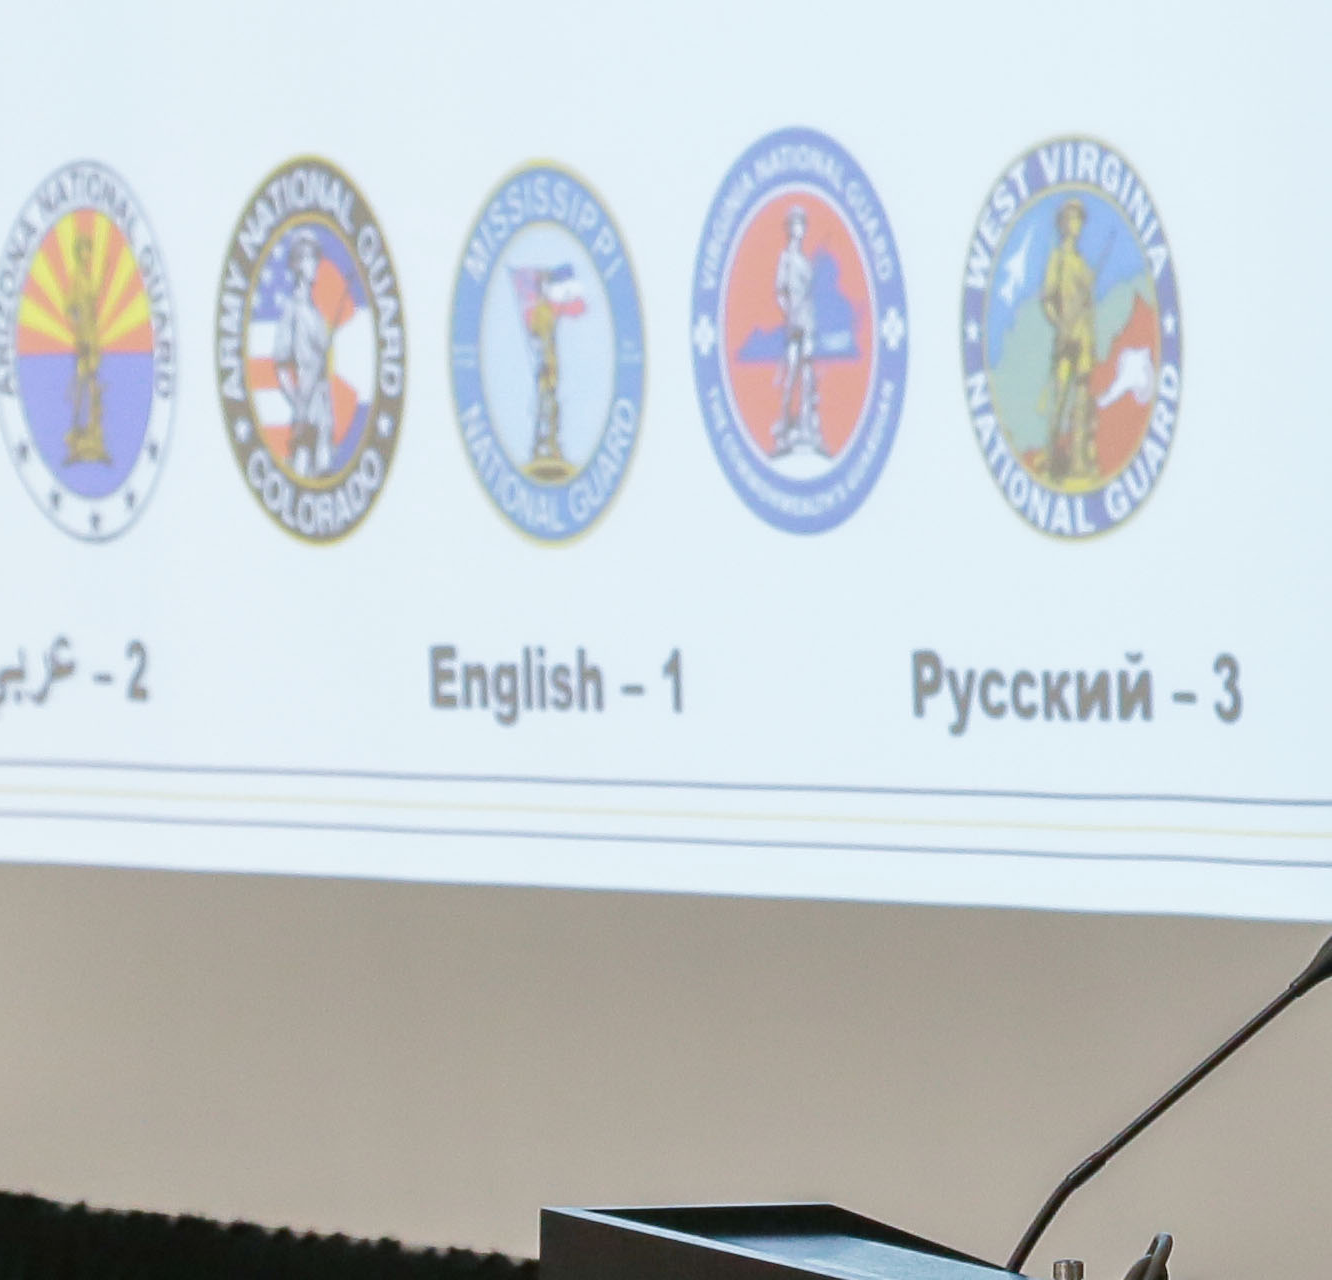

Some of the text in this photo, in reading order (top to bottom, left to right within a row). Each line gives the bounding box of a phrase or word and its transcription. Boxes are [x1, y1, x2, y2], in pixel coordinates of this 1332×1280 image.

[465, 175, 624, 281] MISSISSIPPI
[968, 141, 1168, 290] WEST VIRGINIA
[219, 168, 403, 400] ARMY NATIONAL GUARD
[248, 448, 383, 535] COLORADO
[462, 401, 564, 533] NATIONAL
[568, 397, 637, 521] GUARD
[968, 370, 1096, 536] NATIONAL
[1102, 362, 1180, 522] GUARD
[125, 638, 150, 703] 2
[428, 644, 605, 727] English
[662, 647, 683, 714] 1
[911, 648, 1154, 737] Русский
[1212, 652, 1244, 725] 3
